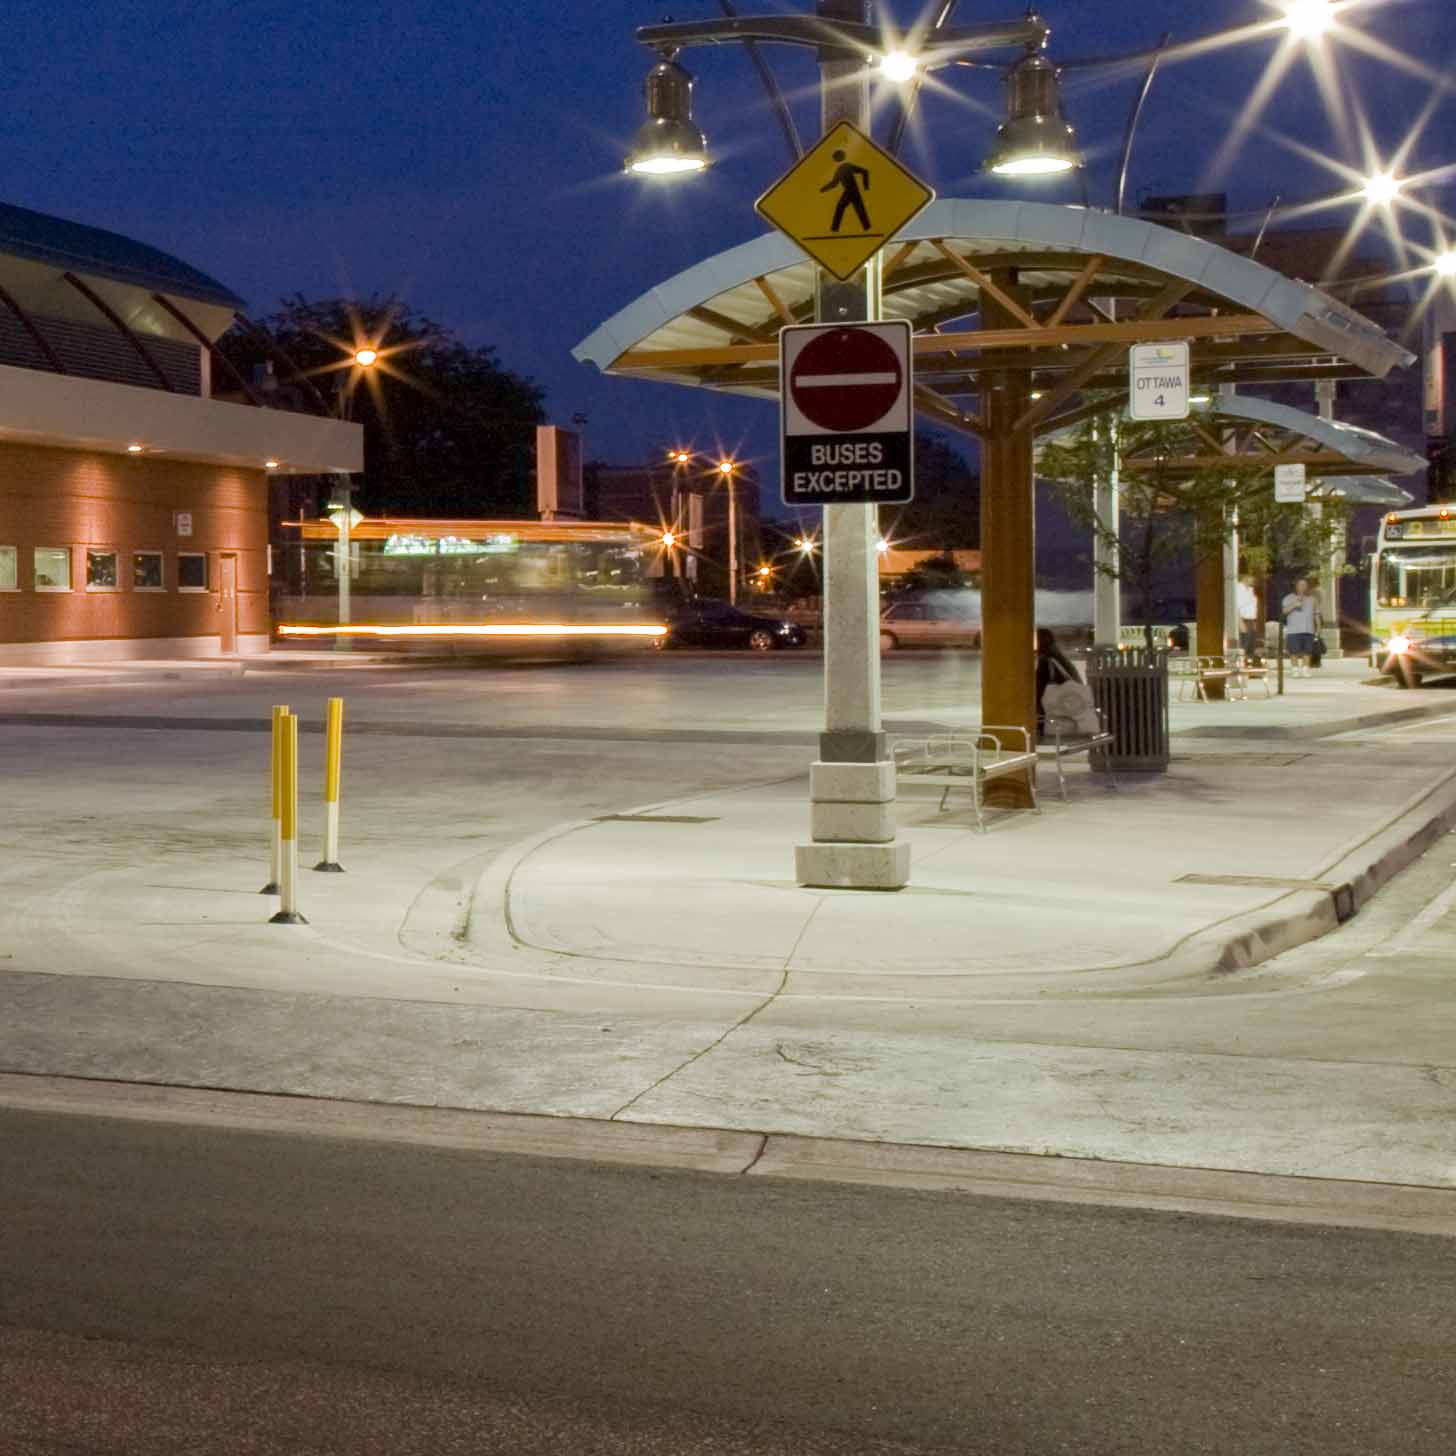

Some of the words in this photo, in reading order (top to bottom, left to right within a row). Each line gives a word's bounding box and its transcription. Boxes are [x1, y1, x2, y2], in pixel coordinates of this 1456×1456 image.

[1136, 376, 1183, 390] OTTAWA
[1154, 394, 1165, 406] 4
[812, 442, 883, 465] BUSES
[793, 469, 902, 492] EXCEPTED
